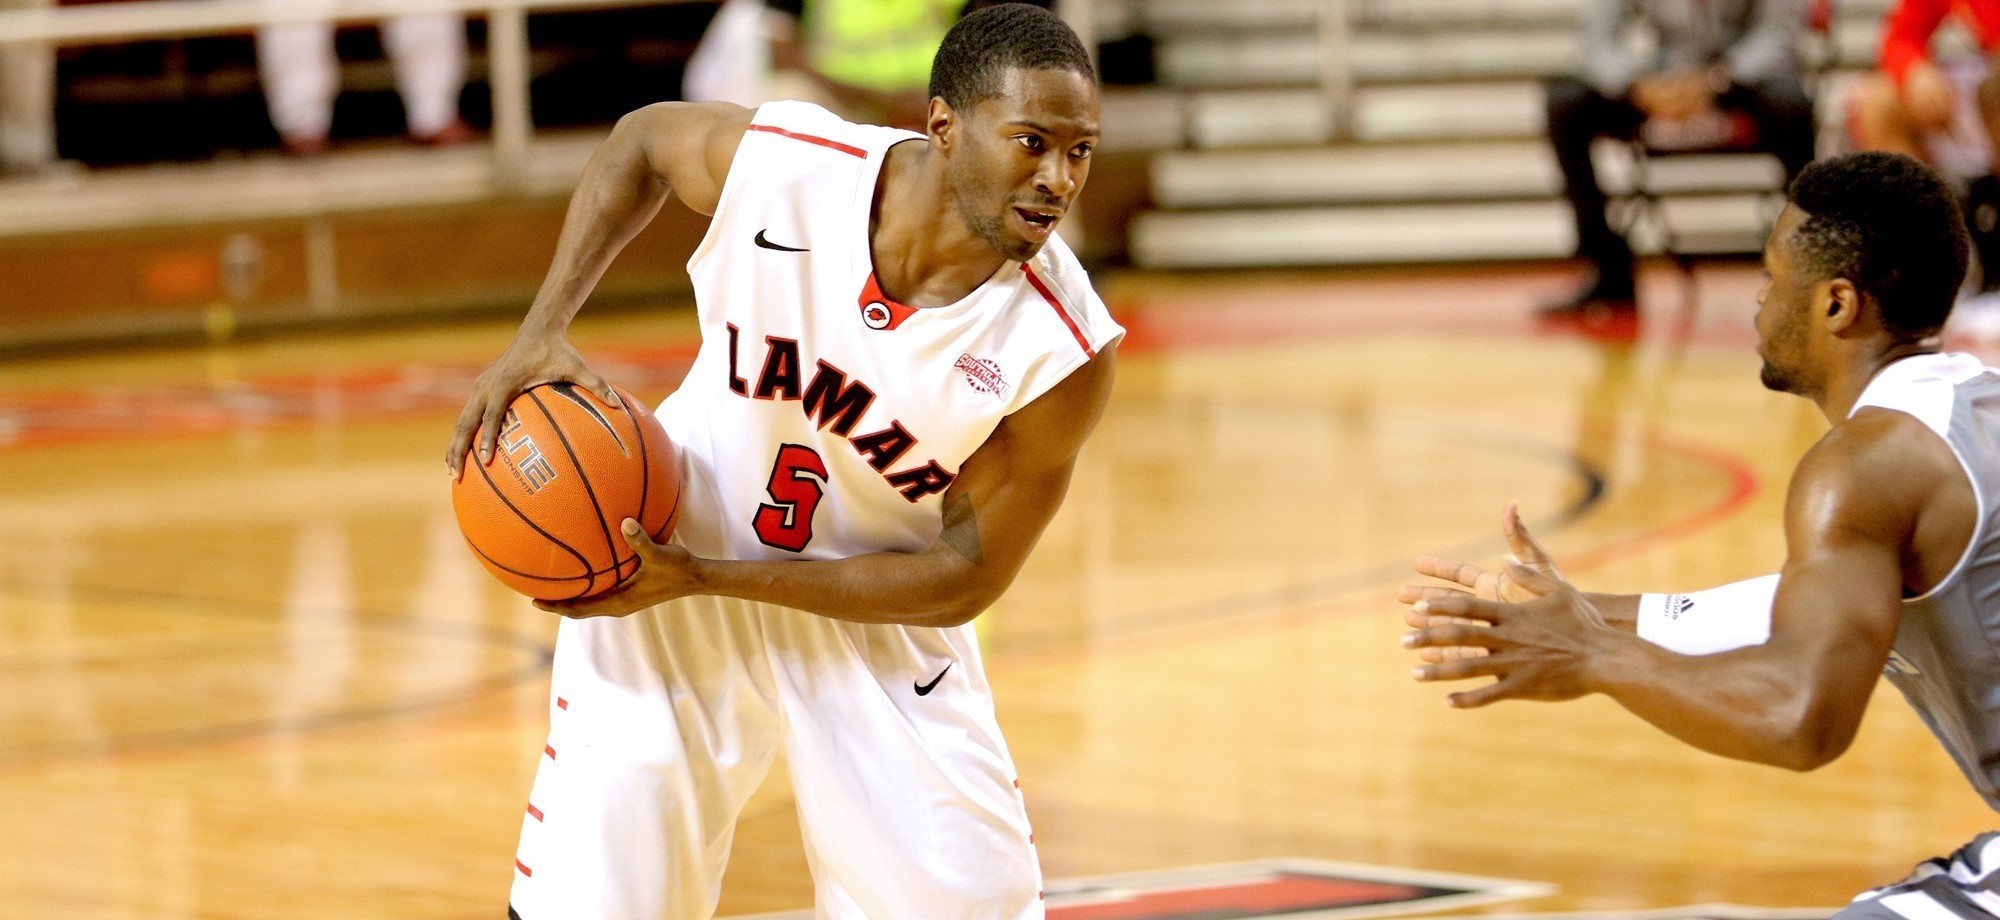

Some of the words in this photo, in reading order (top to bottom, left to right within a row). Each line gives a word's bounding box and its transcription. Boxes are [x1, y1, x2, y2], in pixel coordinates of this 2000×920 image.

[726, 321, 957, 503] LAMAR
[956, 354, 1010, 401] SOUTHLAND
[496, 445, 534, 495] PIONSHIP
[752, 443, 829, 553] 5
